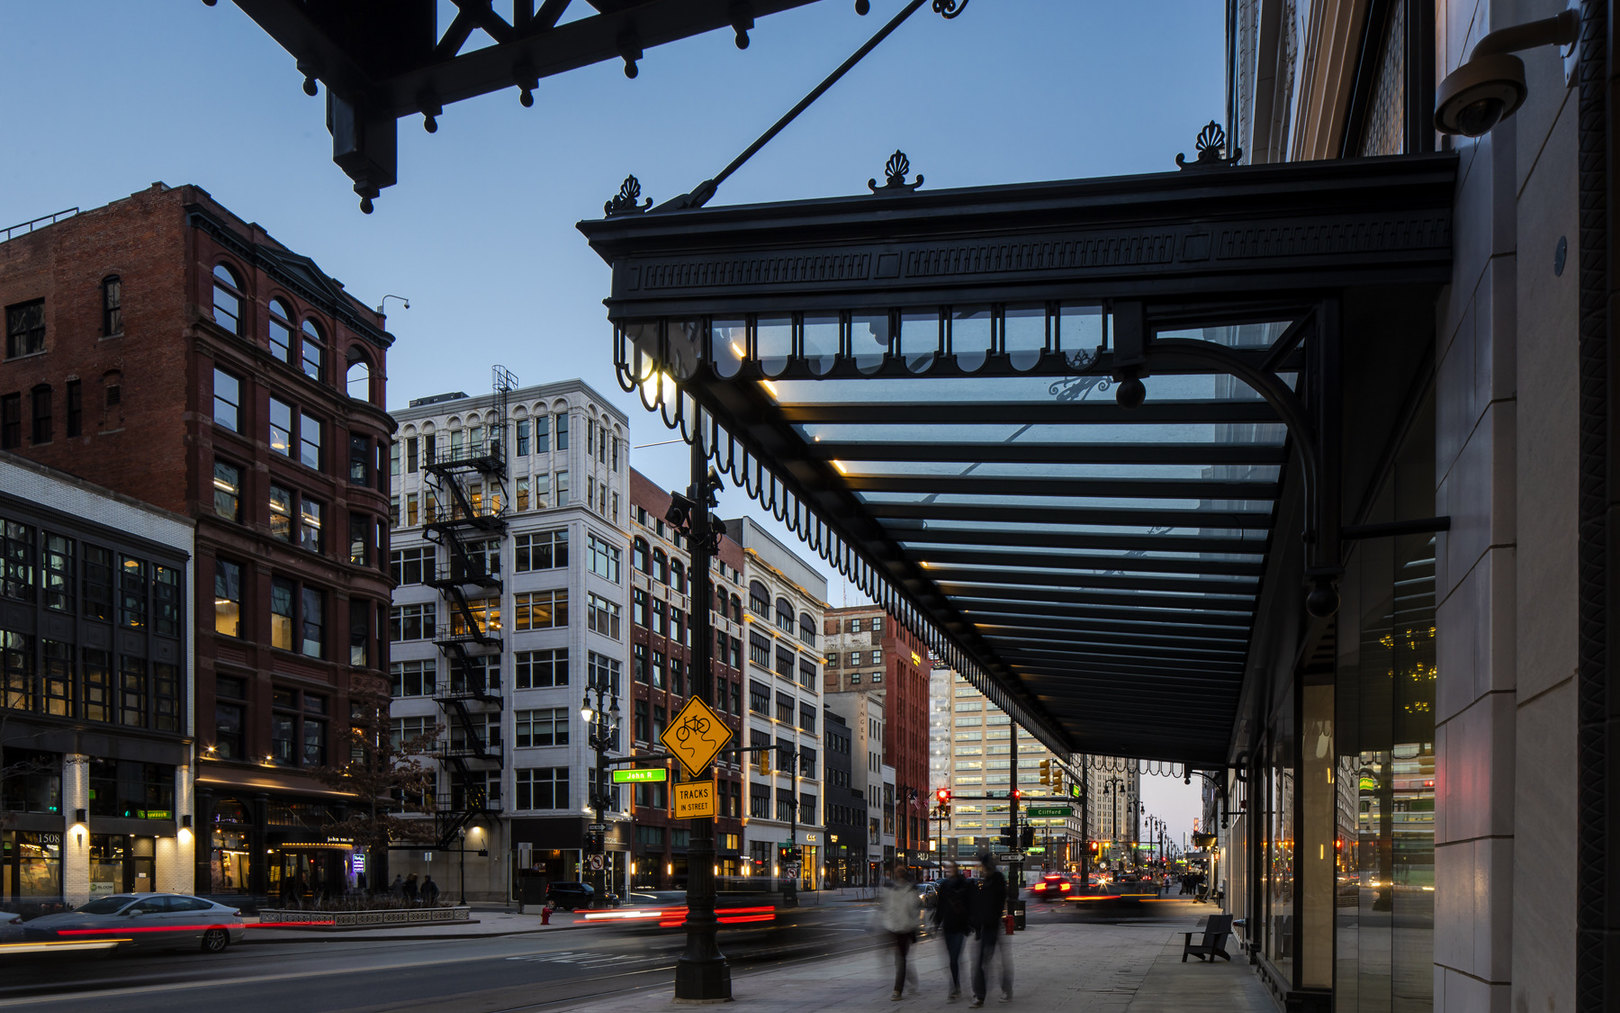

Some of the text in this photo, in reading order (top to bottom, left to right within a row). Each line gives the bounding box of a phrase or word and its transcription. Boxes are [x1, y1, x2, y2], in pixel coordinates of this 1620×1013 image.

[626, 772, 645, 780] John
[680, 788, 709, 799] TRACKS
[687, 802, 708, 811] STREET
[38, 833, 61, 843] 1508
